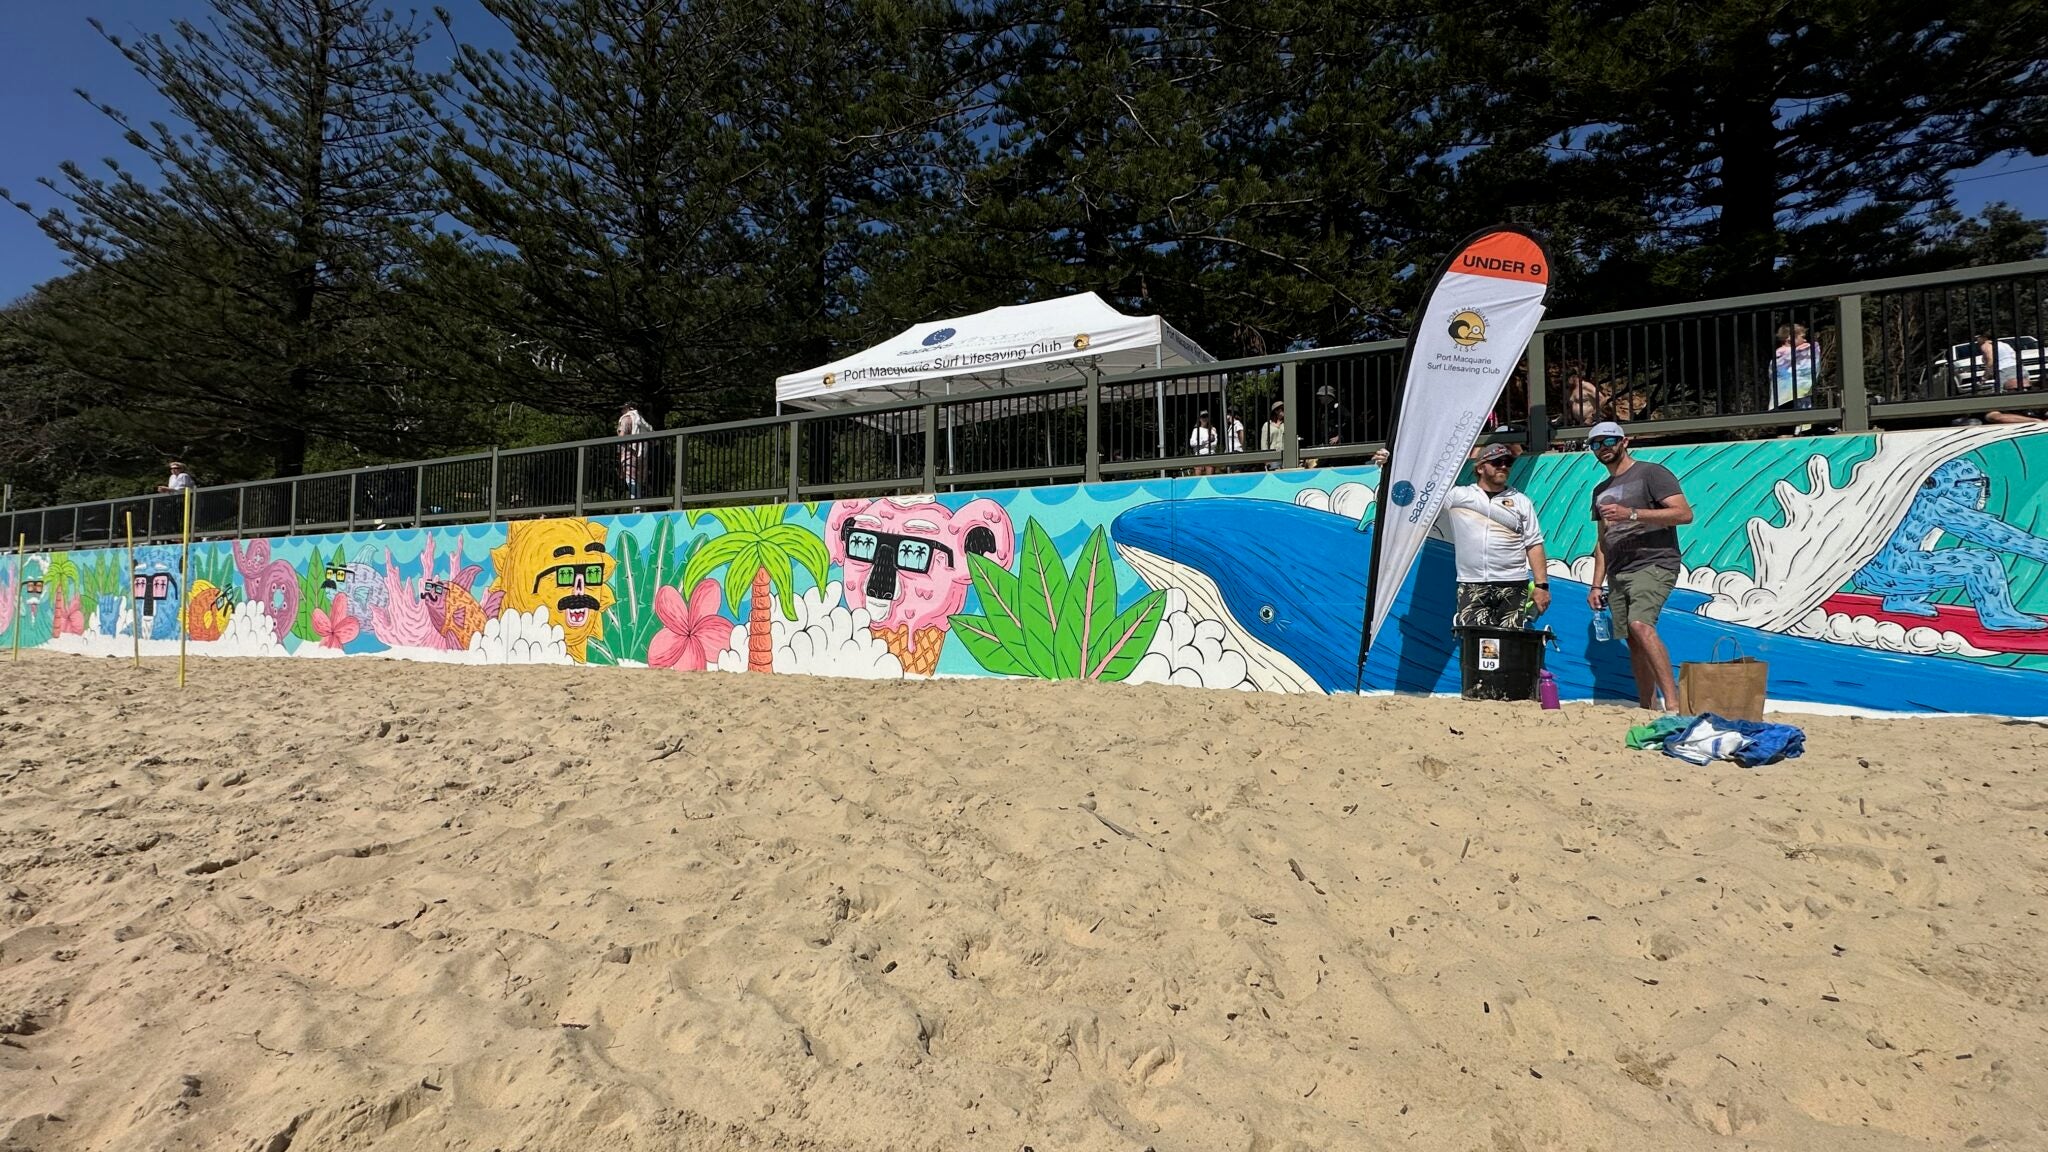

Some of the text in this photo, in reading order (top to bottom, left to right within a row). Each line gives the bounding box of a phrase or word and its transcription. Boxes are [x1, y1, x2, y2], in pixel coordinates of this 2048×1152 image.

[1463, 254, 1541, 275] UNDER 9
[844, 368, 866, 382] Port
[933, 354, 960, 370] Surf
[962, 347, 1027, 366] Lifesaving
[1030, 340, 1062, 355] Club
[1436, 353, 1492, 365] Port Macquarie
[1427, 362, 1501, 375] Surf Lifesaving Club
[1482, 661, 1495, 669] U9
